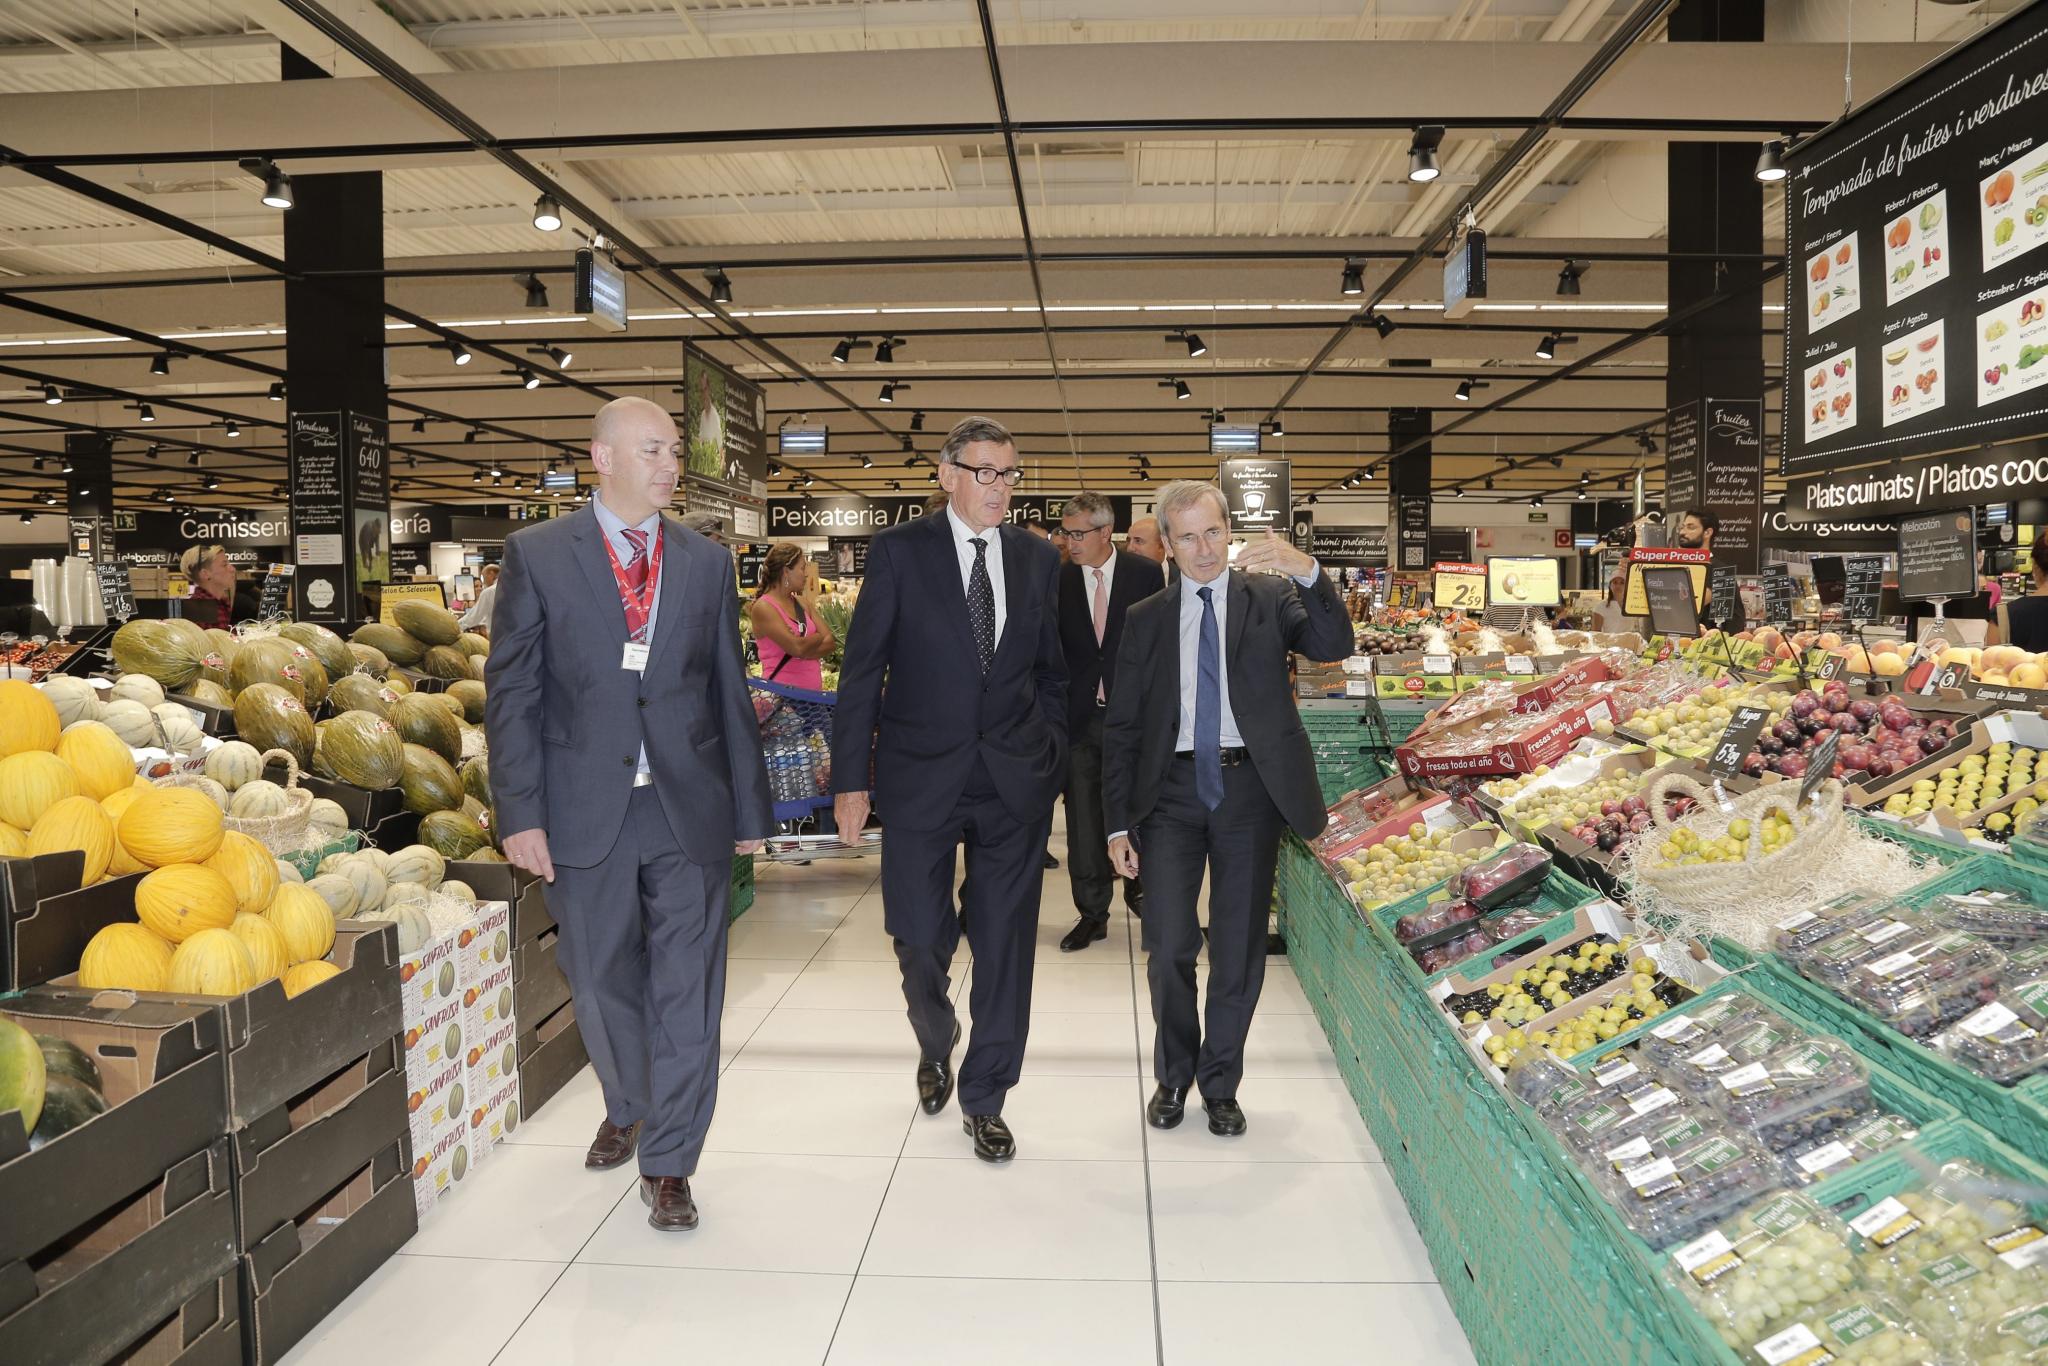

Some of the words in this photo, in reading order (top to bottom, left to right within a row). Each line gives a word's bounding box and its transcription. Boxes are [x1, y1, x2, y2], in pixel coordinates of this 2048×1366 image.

[1979, 154, 1999, 170] Març
[2007, 137, 2034, 155] Marzo
[1803, 157, 1875, 219] Temporada
[1877, 144, 1896, 178] de
[1897, 122, 1952, 177] fruites
[1955, 110, 1965, 137] i
[1885, 197, 1906, 213] Febrer
[1912, 182, 1940, 199] Febrero
[1977, 283, 2016, 302] Setembre
[1883, 318, 1901, 335] Agost
[1906, 311, 1928, 328] Agosto
[1714, 409, 1750, 427] Fruites
[296, 420, 330, 433] Verdures
[1735, 435, 1759, 446] Frutas
[359, 446, 380, 469] 640
[1706, 461, 1759, 476] Compromesos
[1716, 474, 1728, 484] tot
[1806, 482, 1845, 510] Plats
[1846, 474, 1914, 506] cuinats
[1915, 468, 1927, 505] /
[1929, 464, 1999, 496] Platos
[772, 504, 888, 527] Peixateria
[180, 516, 290, 539] Carnisseri
[1901, 518, 1941, 533] Melocotón
[1340, 536, 1376, 549] proteïna
[1377, 536, 1387, 546] de
[1331, 548, 1356, 557] proteína
[1356, 547, 1364, 555] de
[1364, 547, 1387, 557] pescado
[1633, 550, 1668, 562] Super
[1669, 551, 1706, 561] Precio
[96, 565, 117, 575] MELÓN
[1437, 563, 1460, 573] Super
[1461, 564, 1485, 573] Precio
[406, 585, 436, 593] Selección
[1550, 680, 1566, 696] fresas
[1976, 687, 1998, 700] Campos
[1998, 690, 2006, 699] de
[2005, 690, 2028, 702] Jumilla
[1738, 708, 1762, 725] Higos
[1565, 724, 1573, 735] el
[1573, 715, 1586, 730] año
[1527, 735, 1551, 753] fresas
[1550, 720, 1568, 738] todo
[1426, 760, 1450, 771] fresas
[1450, 759, 1468, 770] todo
[1469, 758, 1477, 768] el
[1478, 756, 1493, 767] año
[1828, 1305, 1869, 1335] pepitas
